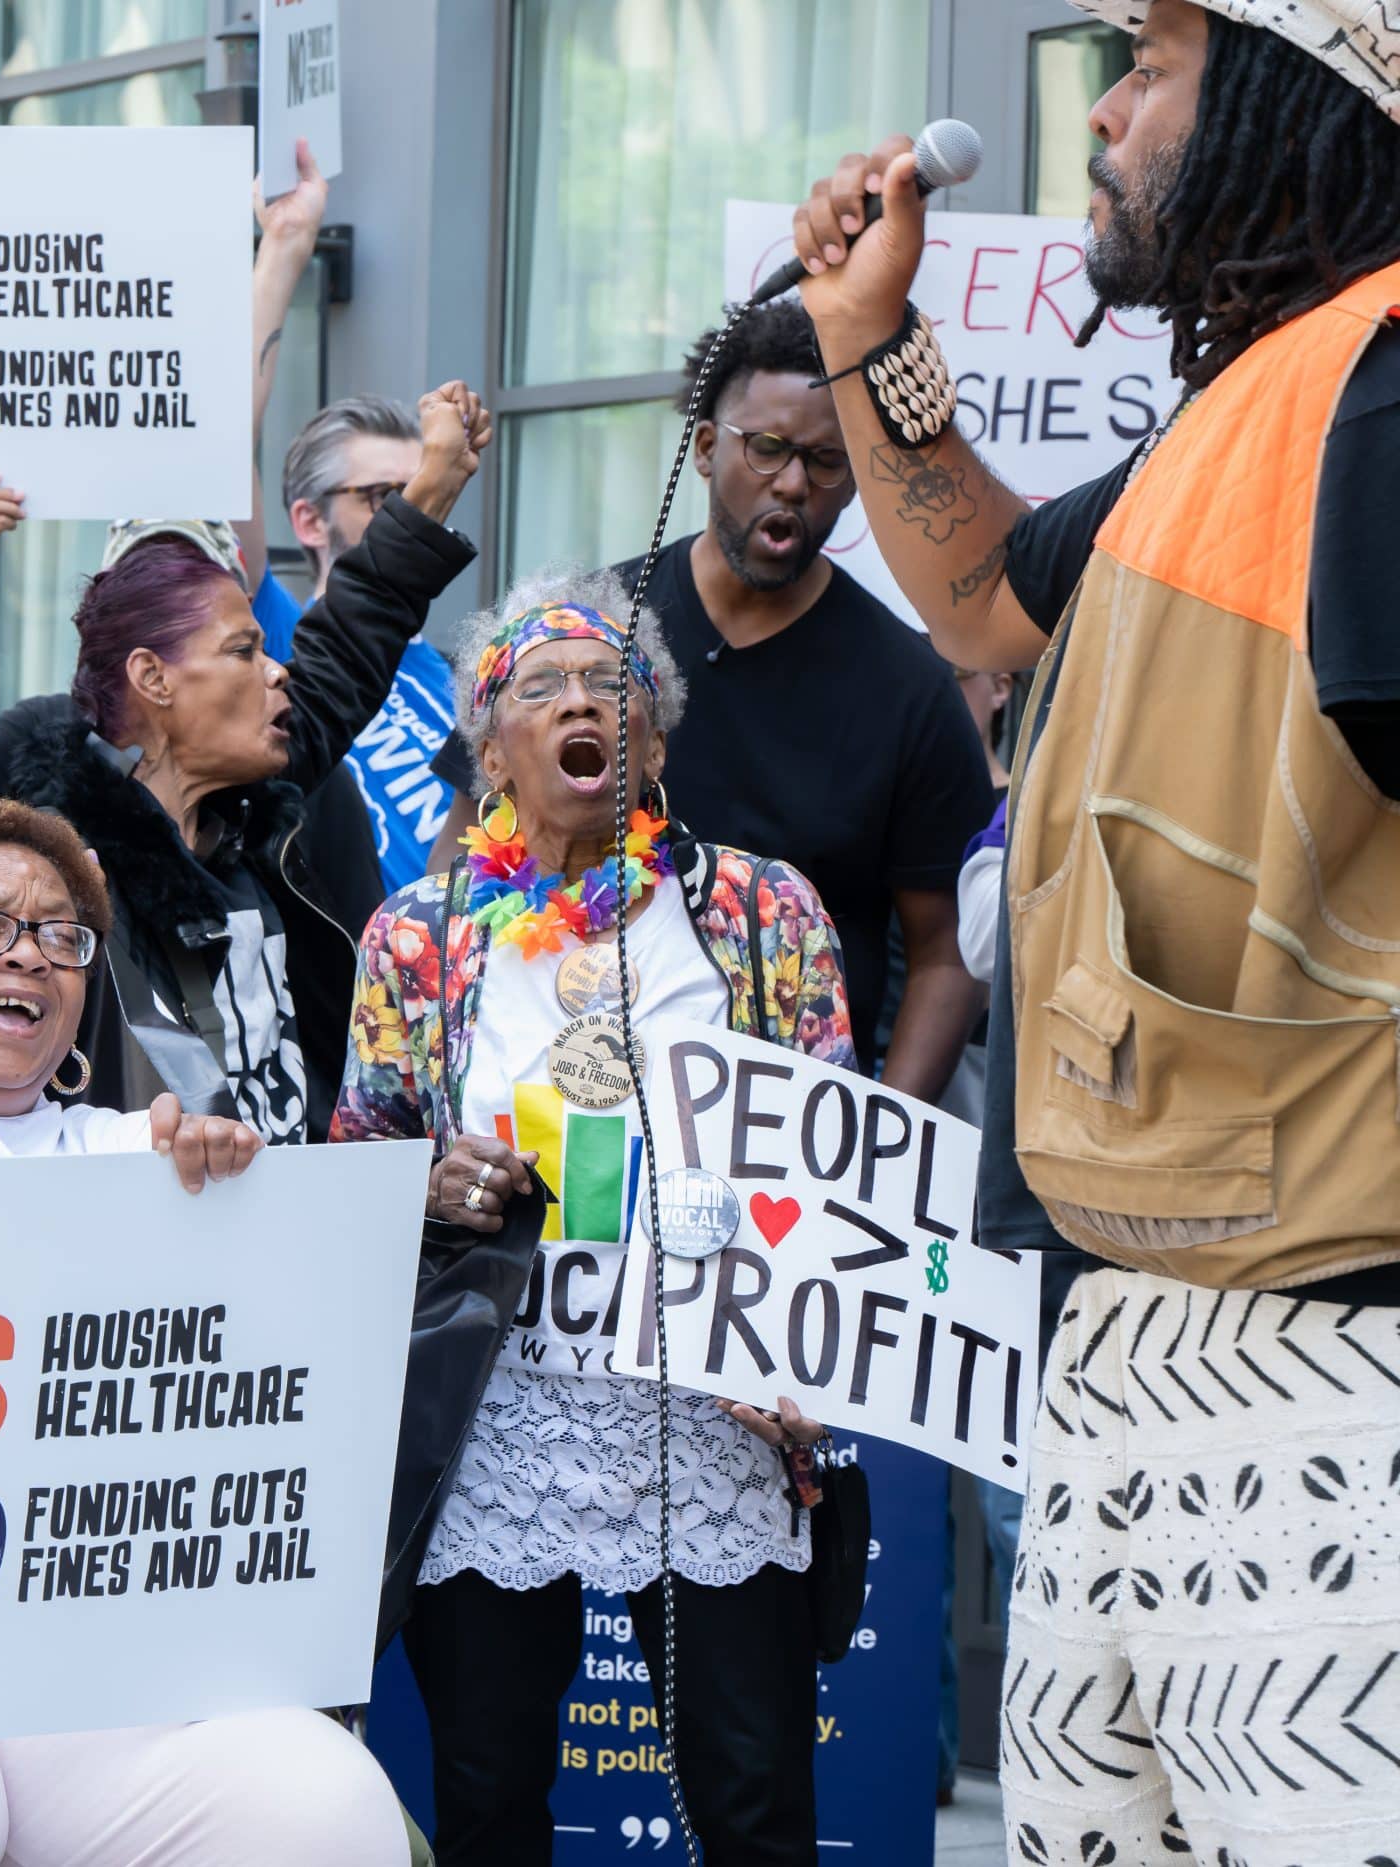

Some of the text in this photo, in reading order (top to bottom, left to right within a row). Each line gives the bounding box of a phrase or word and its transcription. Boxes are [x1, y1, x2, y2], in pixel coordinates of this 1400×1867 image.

[109, 350, 181, 387] CUTS
[65, 391, 120, 428] AND
[553, 1018, 585, 1049] MARCH
[588, 1015, 602, 1026] ON
[553, 1059, 631, 1093] JOBS & FREEDOM
[586, 1060, 604, 1071] FOR
[554, 1077, 582, 1103] AUGUST
[599, 1093, 620, 1108] 1963
[669, 1041, 1022, 1265] PEOPL
[660, 1207, 722, 1229] VOCAL
[636, 1246, 1022, 1468] PROFIT!
[35, 1365, 309, 1440] HEALTHCARE
[210, 1467, 307, 1529] CUTS
[143, 1534, 222, 1595] AND
[567, 1698, 621, 1727] not
[560, 1741, 588, 1770] is
